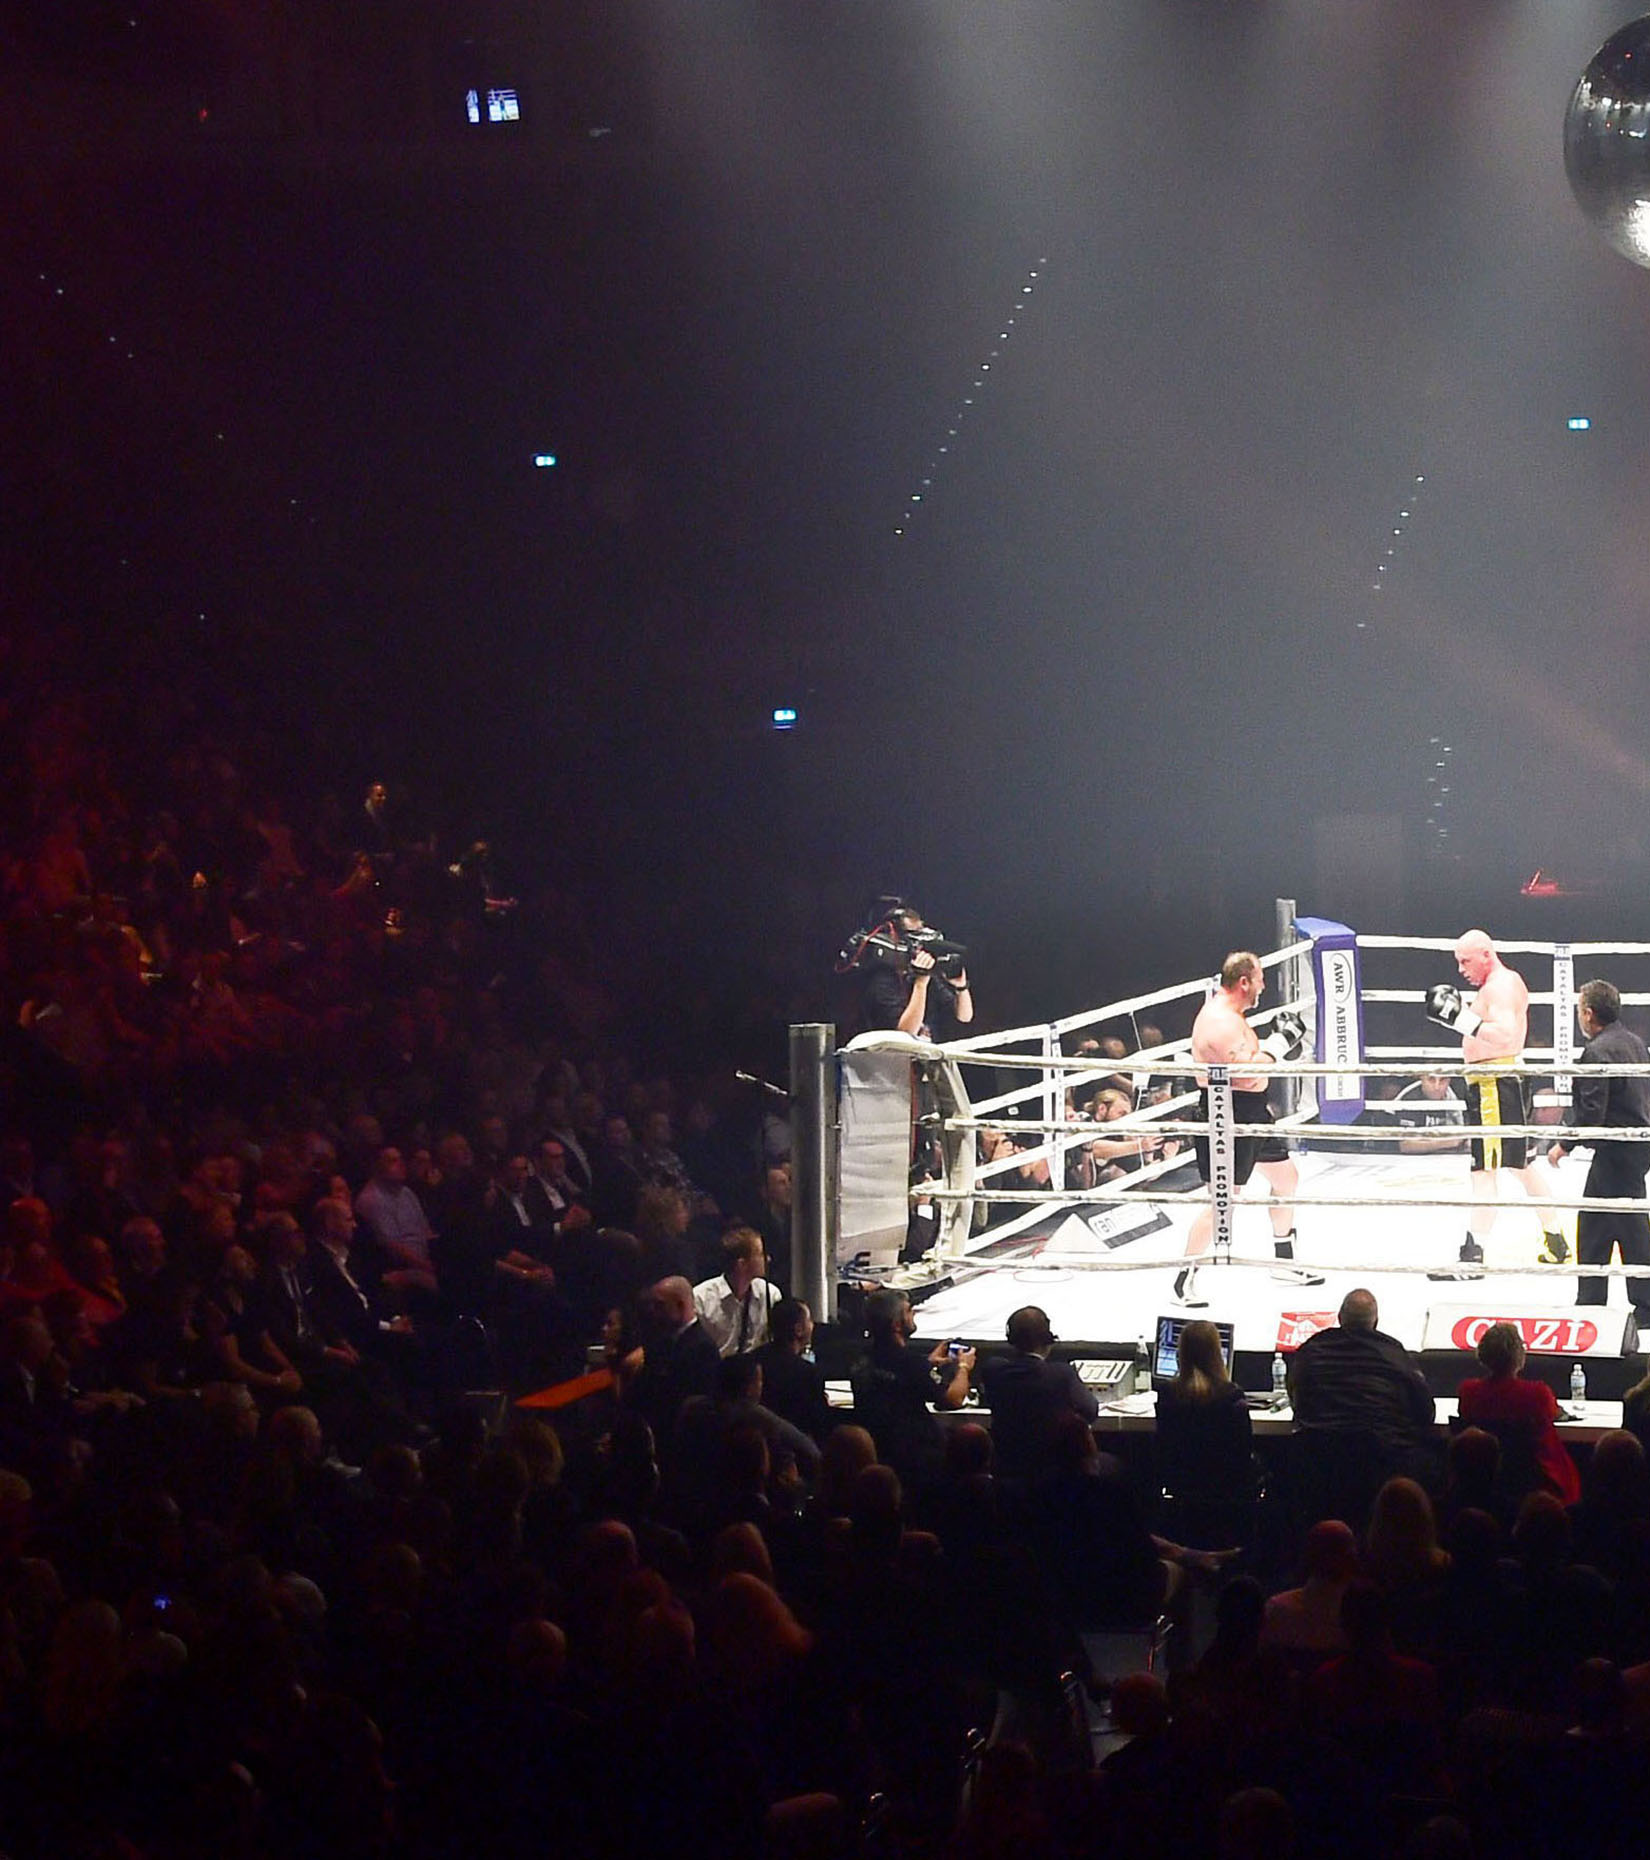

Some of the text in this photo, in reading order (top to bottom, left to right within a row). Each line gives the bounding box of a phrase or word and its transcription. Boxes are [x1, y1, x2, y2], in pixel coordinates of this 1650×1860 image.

[1334, 962, 1345, 994] AWR
[1336, 1006, 1348, 1065] ABBRUC
[1214, 1087, 1226, 1154] CATALTAS
[1216, 1166, 1228, 1241] PROMOTION
